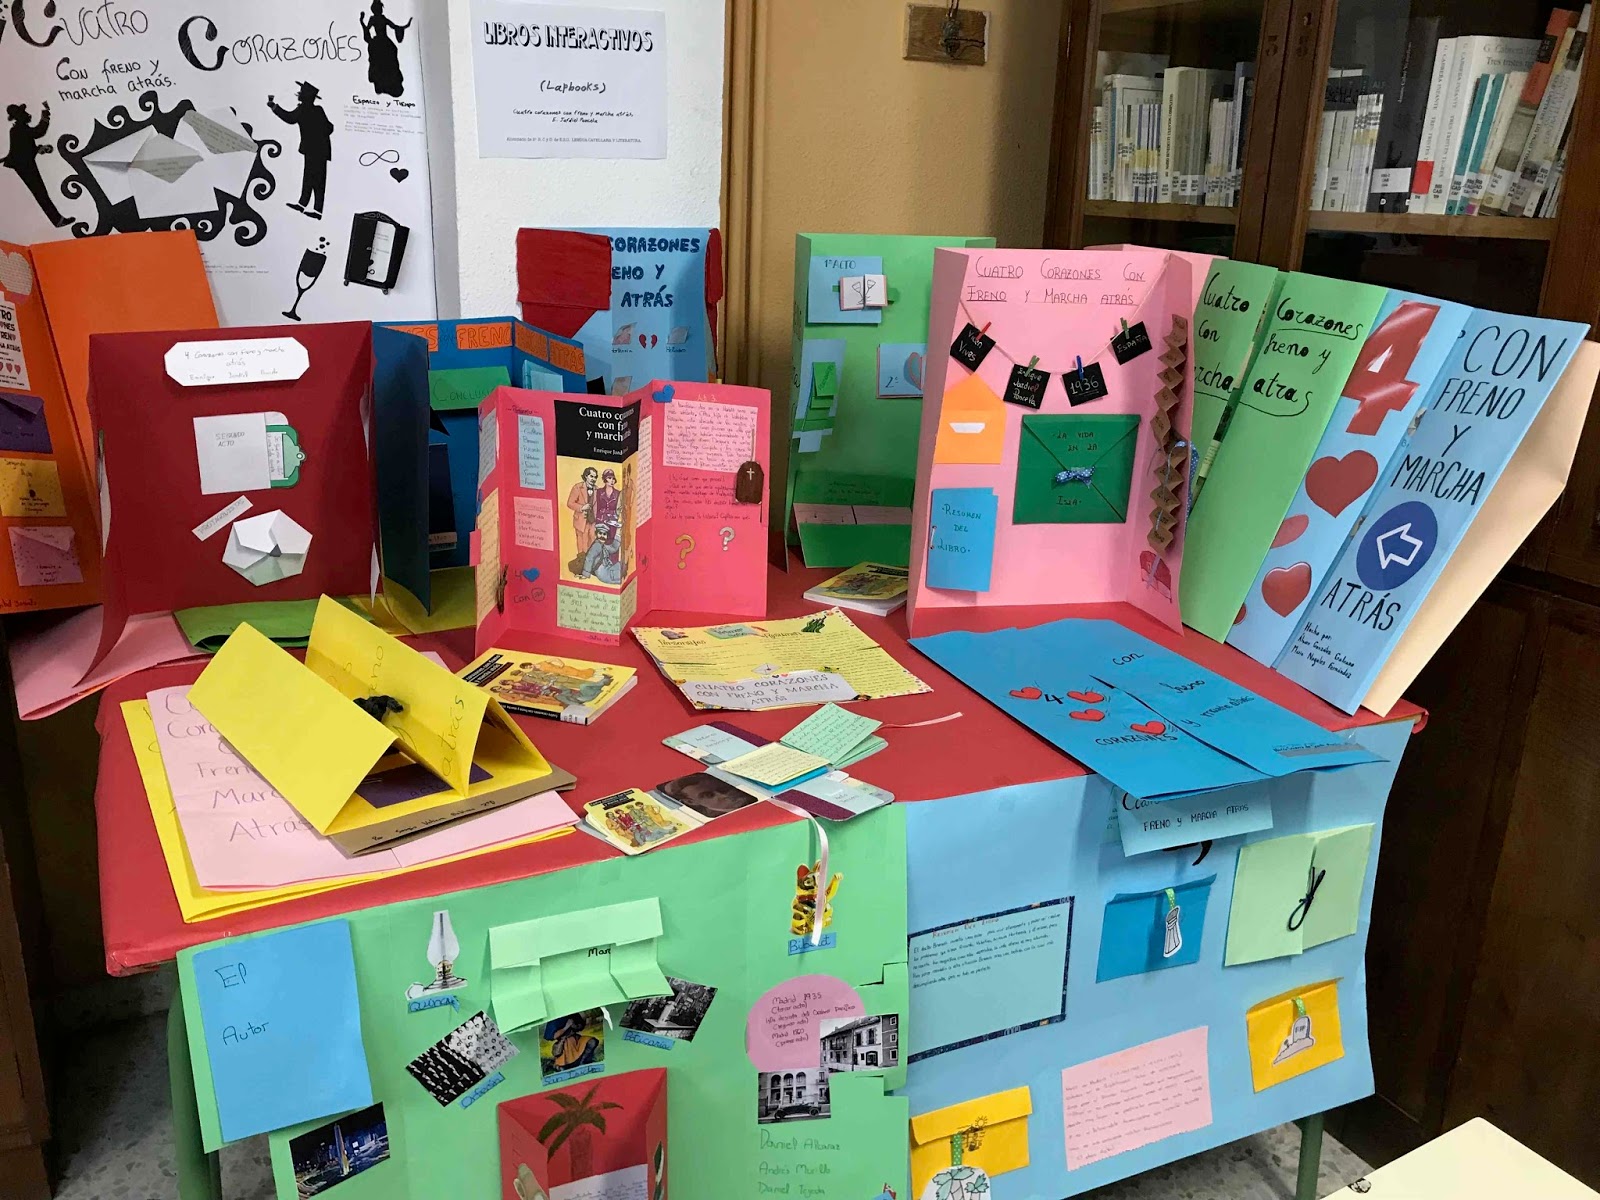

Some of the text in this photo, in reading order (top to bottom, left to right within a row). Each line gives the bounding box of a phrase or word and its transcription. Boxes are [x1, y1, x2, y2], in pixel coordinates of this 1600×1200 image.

[483, 21, 654, 52] LIBROS INTERACTIVOS
[540, 80, 606, 94] (Lapbooks)
[655, 264, 665, 280] Y
[1040, 258, 1101, 280] CORAZONES
[621, 285, 673, 308] ATRÁS
[1044, 288, 1088, 304] MARCHA
[1203, 272, 1250, 313] Cuatro
[1276, 297, 1364, 340] Corazones
[1264, 333, 1331, 375] freno y
[1463, 325, 1567, 382] CON
[1341, 302, 1440, 436] 4
[1069, 376, 1099, 394] 1936
[1433, 377, 1526, 420] FRENO
[579, 406, 612, 419] Cuatro
[586, 430, 592, 440] y
[598, 421, 615, 431] con
[1077, 431, 1094, 439] VIDA
[1442, 424, 1471, 457] Y
[1391, 454, 1486, 506] MARCHA
[1320, 577, 1401, 631] ATRÁS
[1304, 621, 1319, 636] Hecho
[1307, 652, 1326, 667] Nogales
[695, 673, 828, 692] CUATRO CORAZONES
[785, 682, 840, 694] MARCHA
[1044, 691, 1064, 706] 4
[1143, 810, 1218, 832] FRENO MARCHA
[772, 993, 797, 1005] Madrid
[222, 1021, 270, 1046] Autor
[759, 1128, 798, 1151] Daniel
